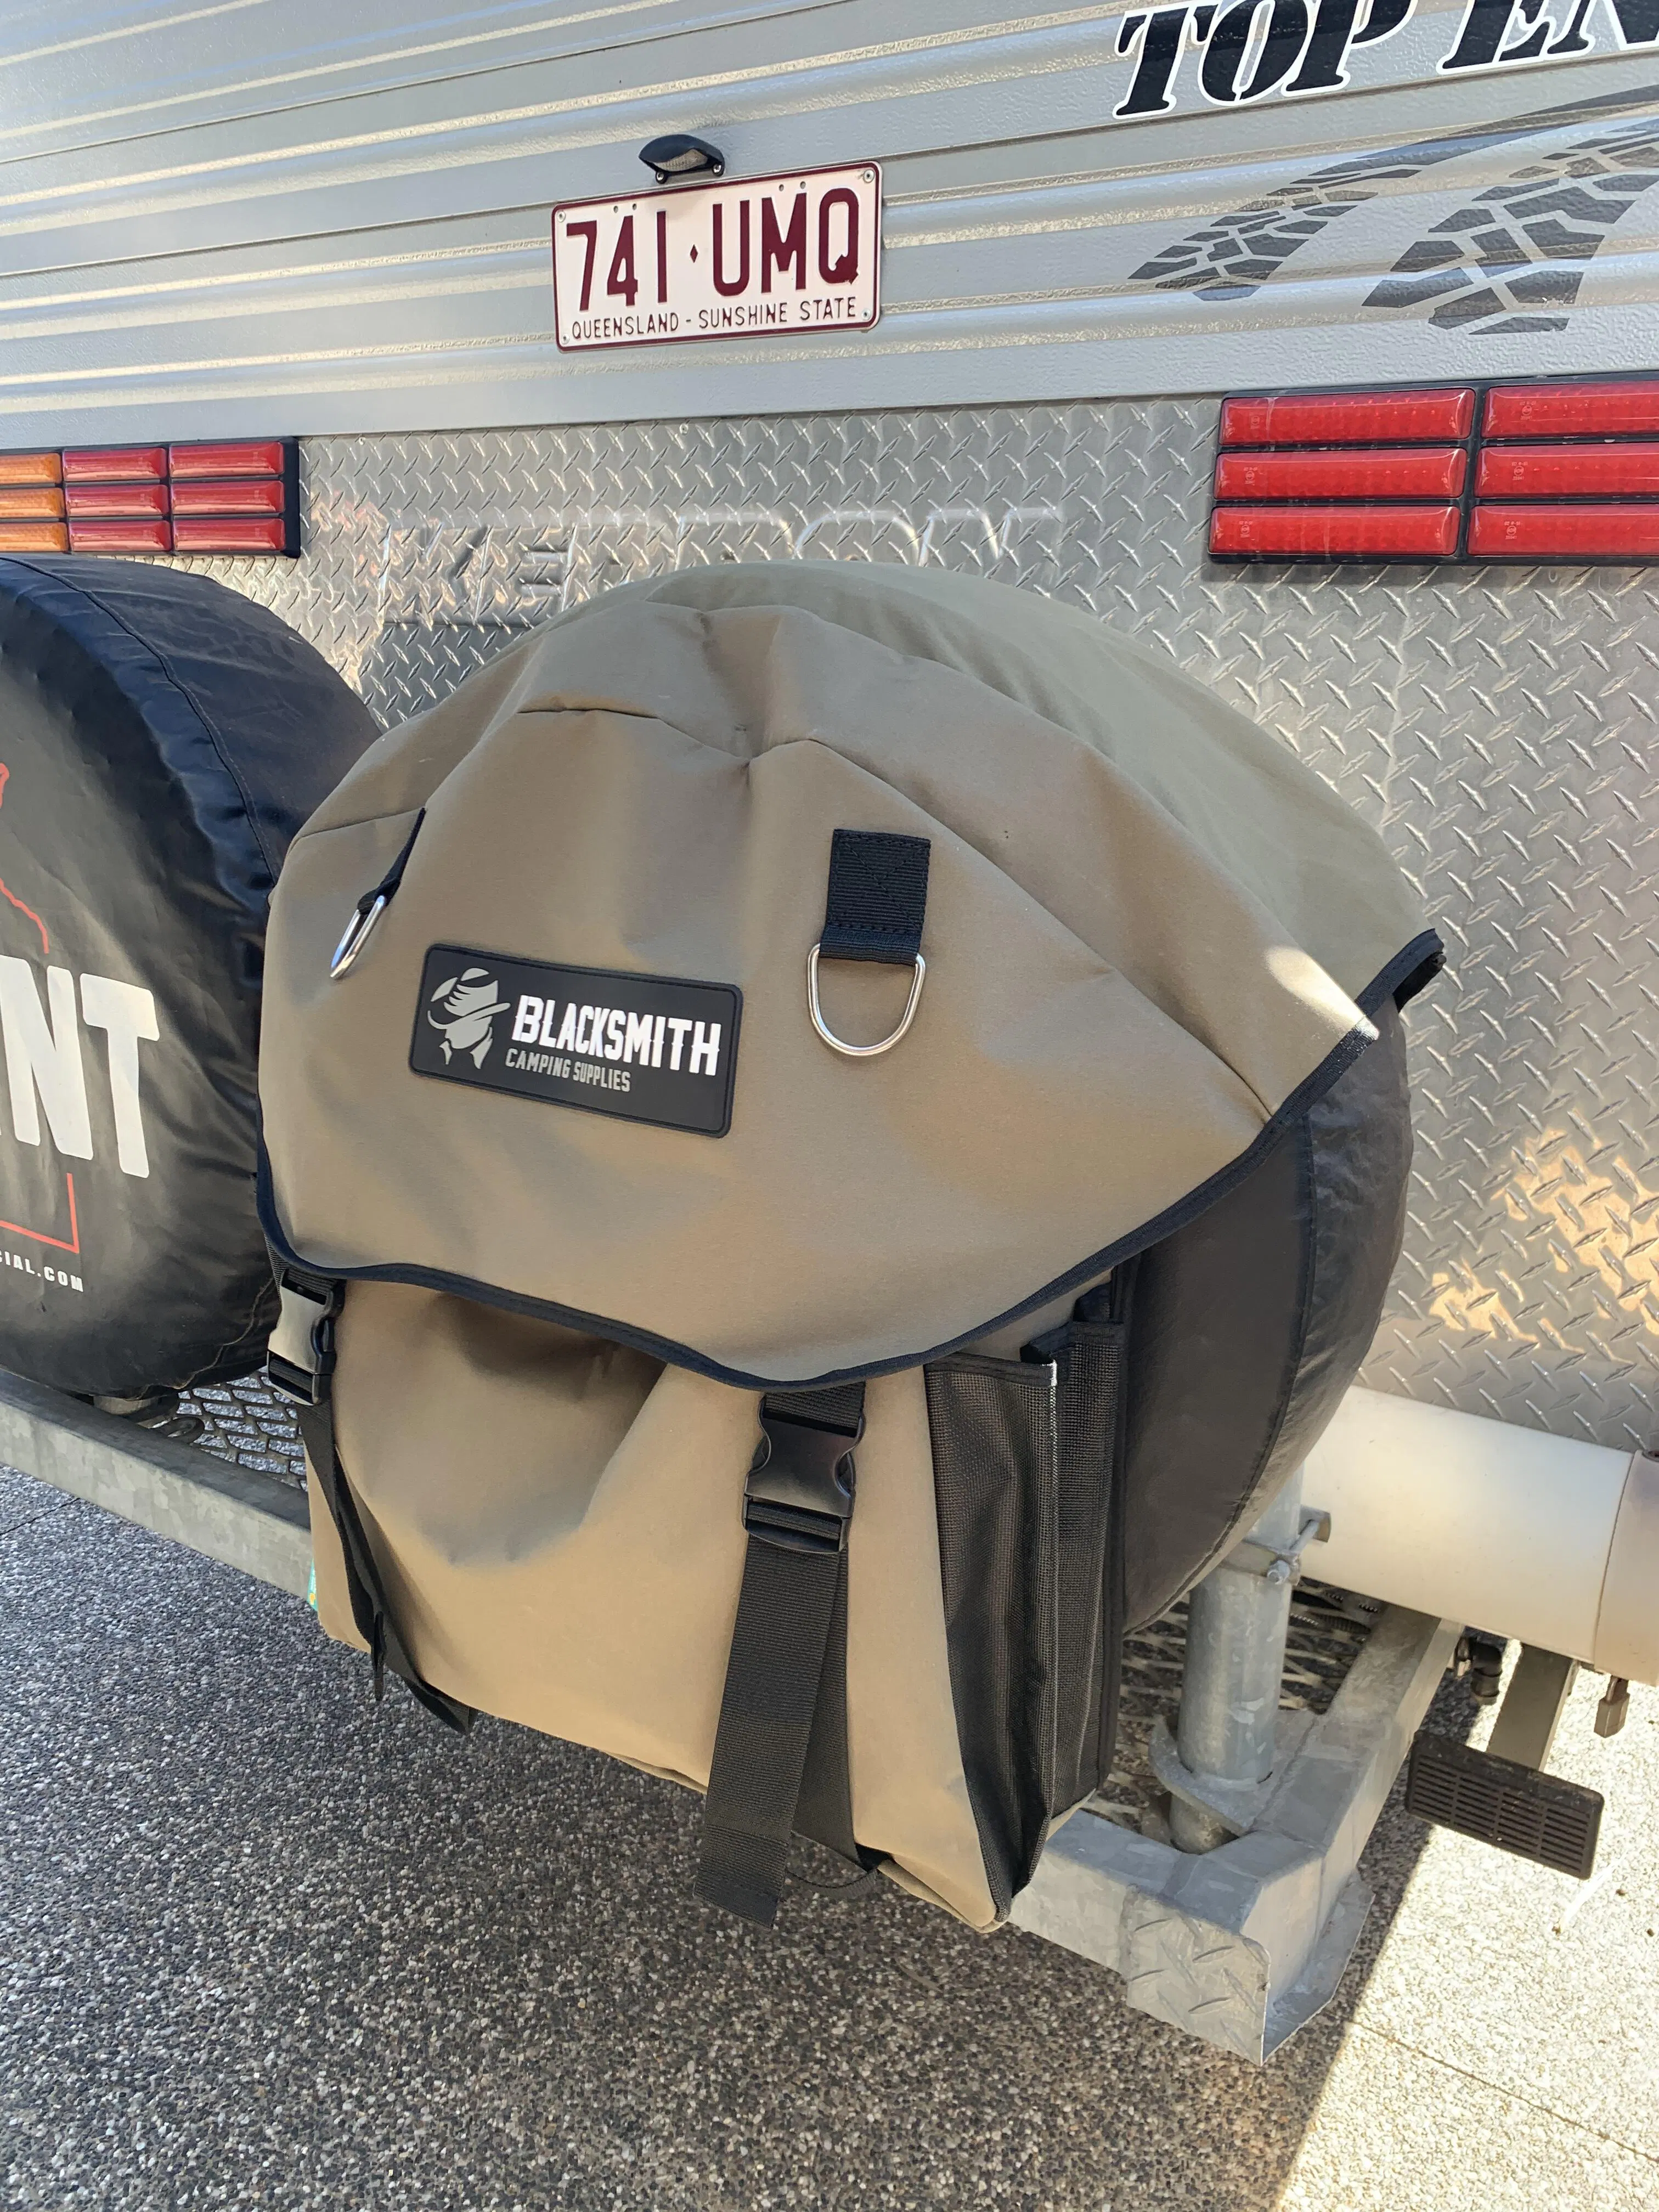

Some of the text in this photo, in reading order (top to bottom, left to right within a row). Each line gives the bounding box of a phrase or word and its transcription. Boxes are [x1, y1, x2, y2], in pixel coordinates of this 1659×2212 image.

[1113, 0, 1416, 119] TOP
[572, 311, 679, 340] QUEENSLAND
[698, 301, 788, 329] SUNSHINE
[800, 297, 856, 320] STATE
[511, 995, 722, 1076] BLACKSMITH
[505, 1047, 631, 1092] CAMPING SUPPLIES
[0, 1249, 83, 1293] IAL.COM
